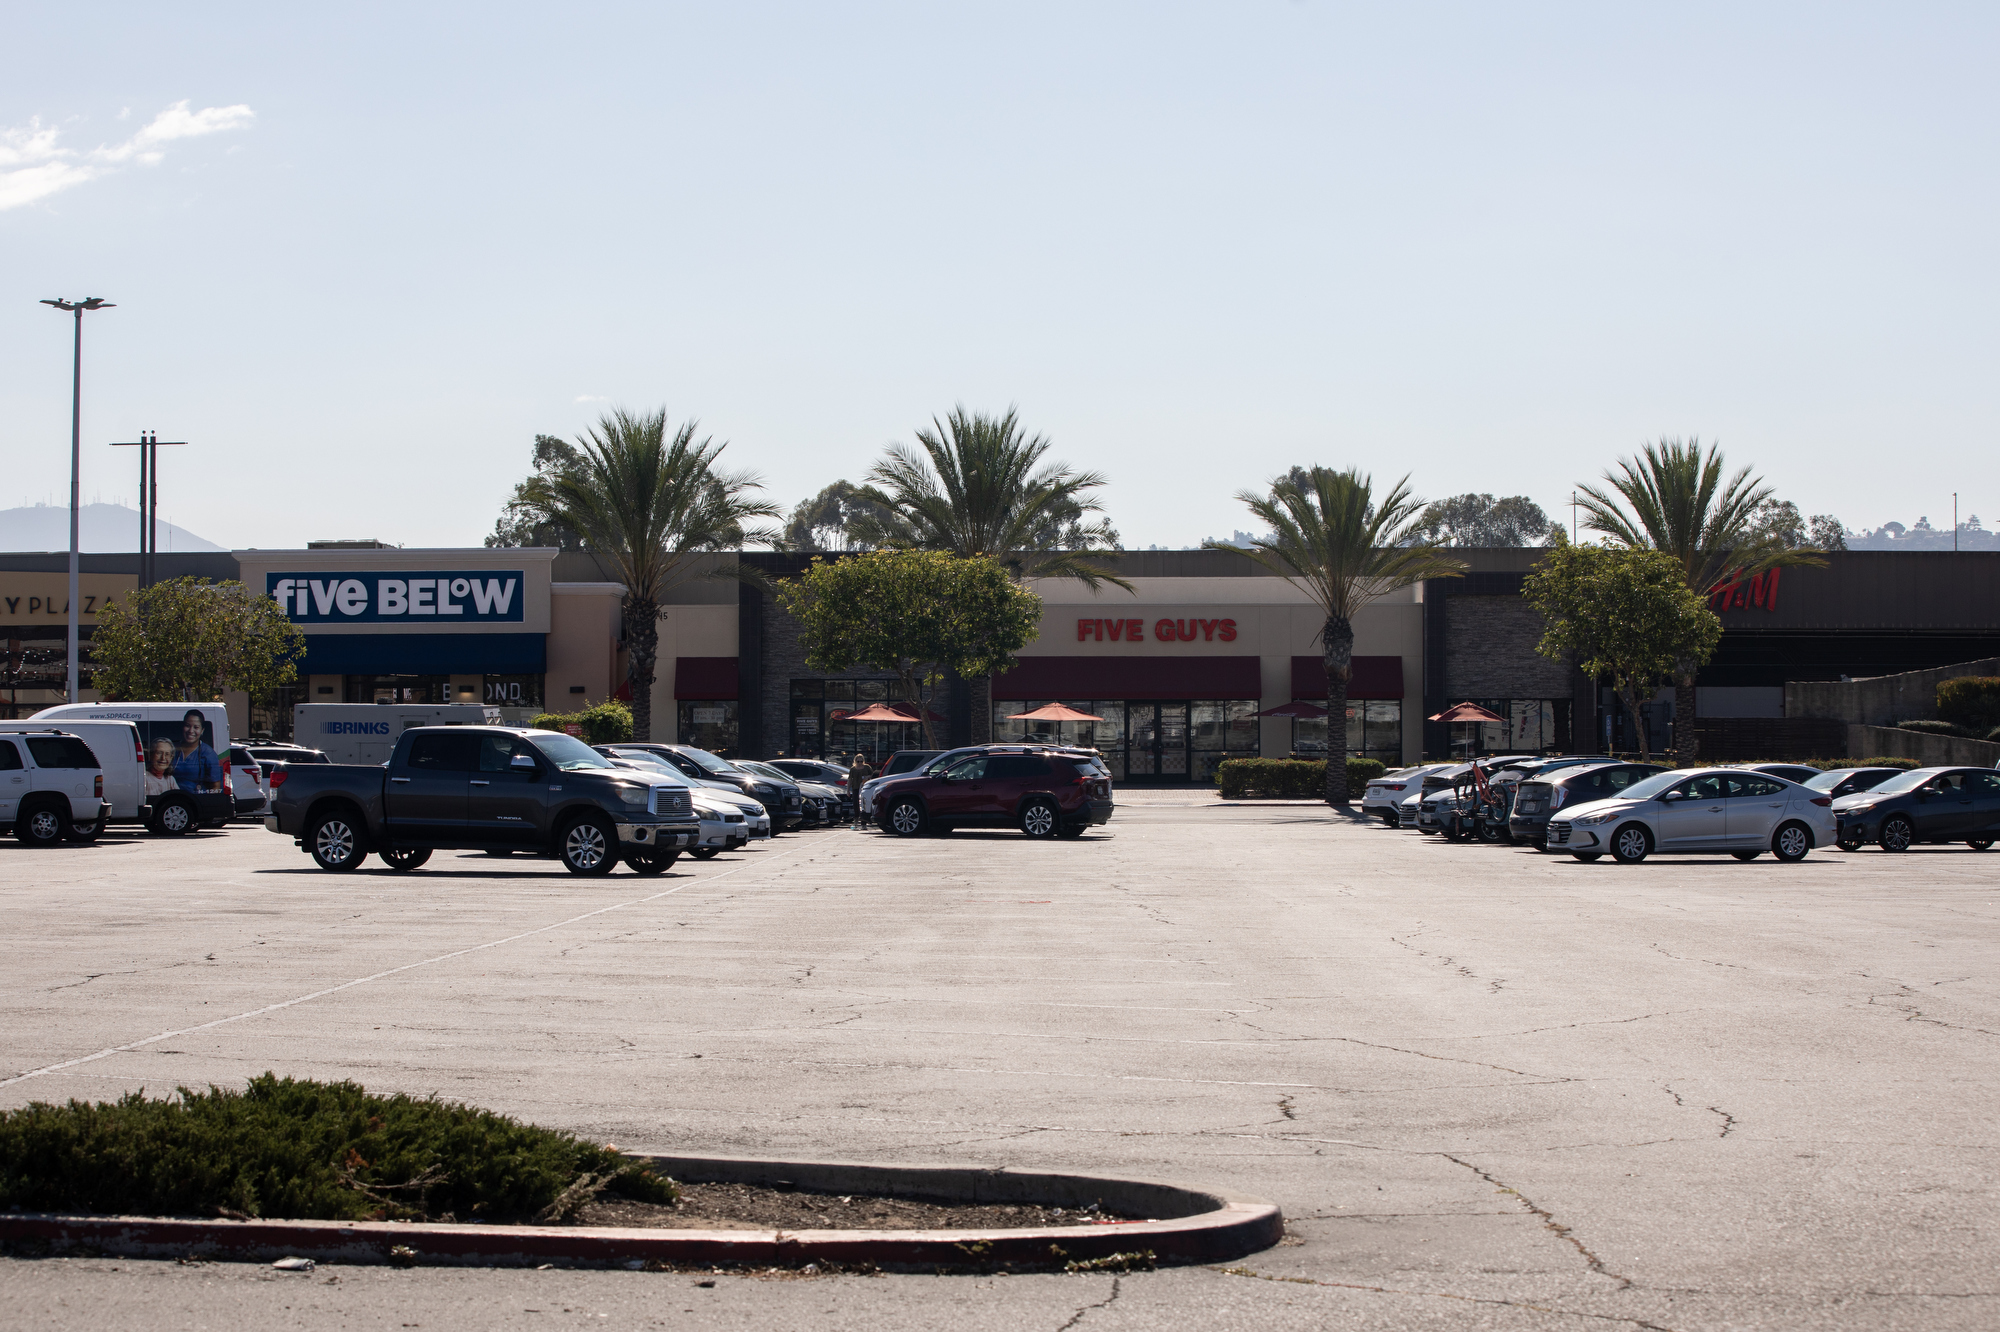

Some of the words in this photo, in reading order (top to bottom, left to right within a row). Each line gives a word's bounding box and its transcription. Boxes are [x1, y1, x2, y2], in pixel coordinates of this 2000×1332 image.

[378, 578, 517, 615] BELOW
[1709, 565, 1781, 612] H&M
[0, 597, 20, 614] Y
[1077, 619, 1144, 642] FIVE
[1155, 618, 1238, 642] GUYS
[332, 721, 389, 735] BRINKS
